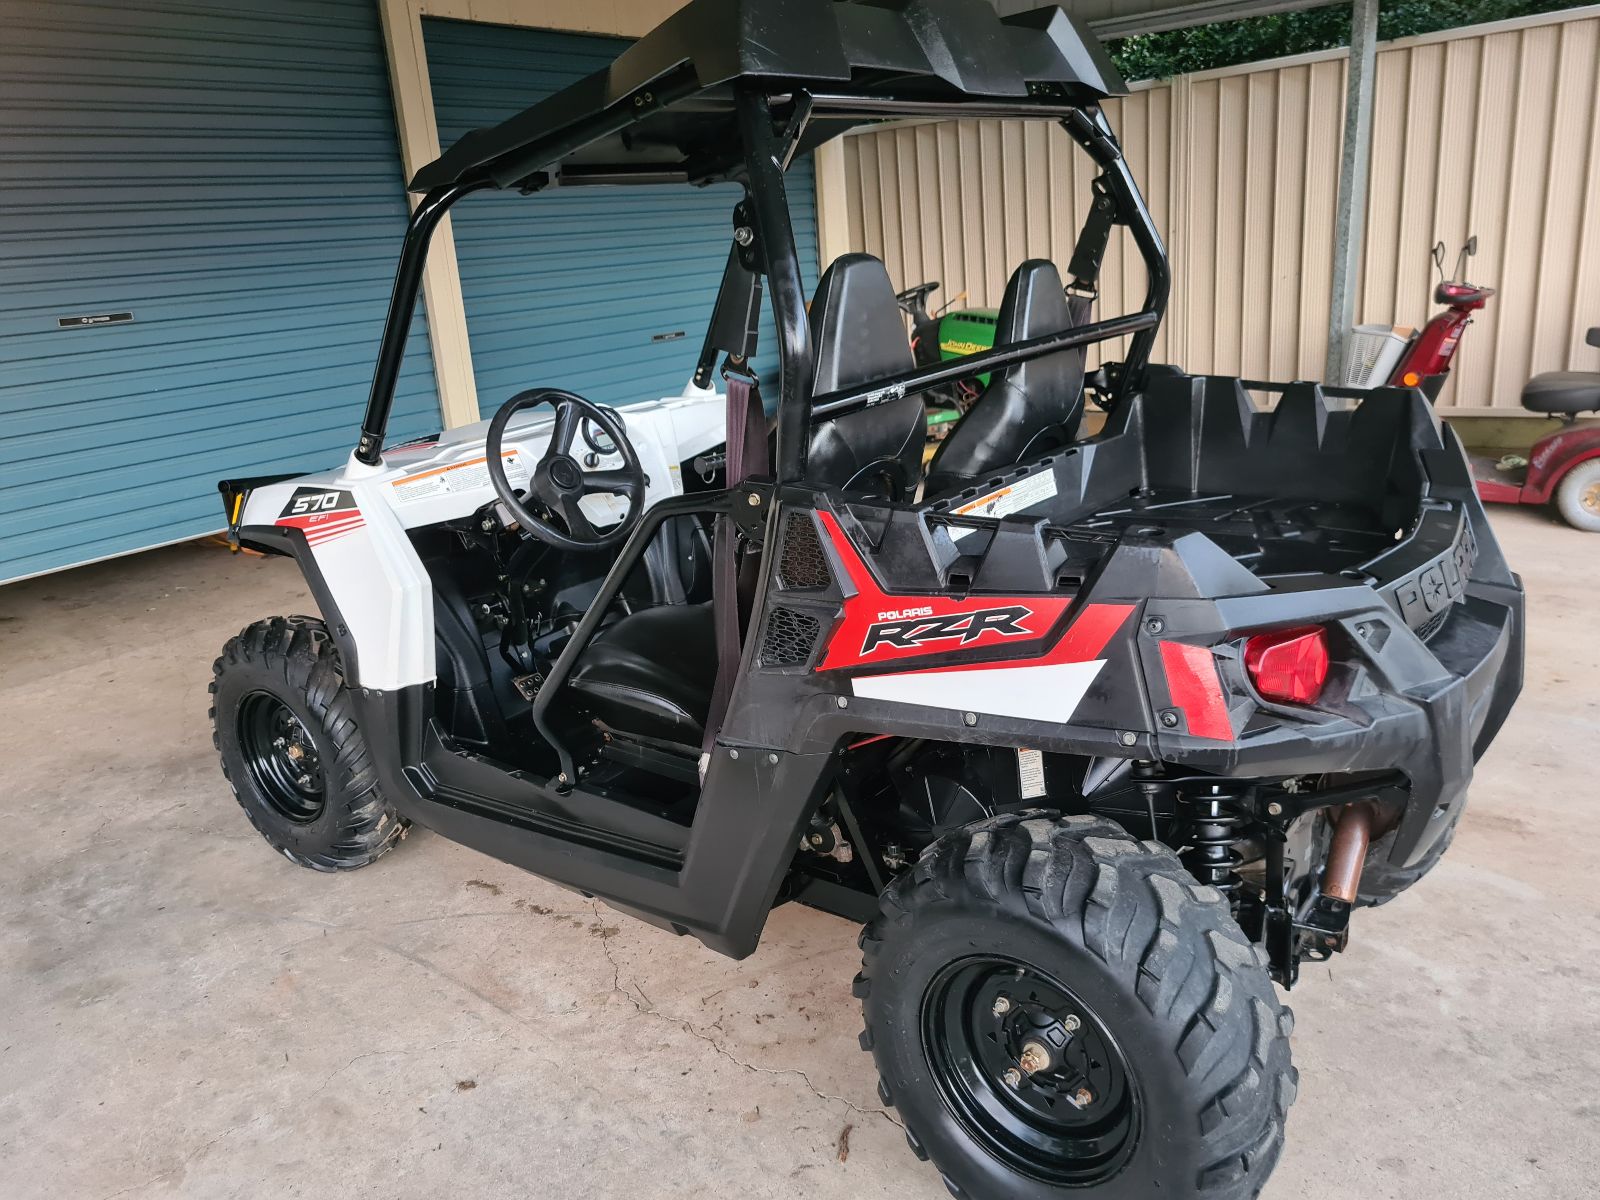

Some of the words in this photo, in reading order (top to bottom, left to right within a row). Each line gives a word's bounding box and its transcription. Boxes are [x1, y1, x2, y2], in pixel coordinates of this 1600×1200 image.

[292, 492, 341, 513] 570
[877, 606, 933, 621] POLARIS
[859, 605, 1034, 657] RZR
